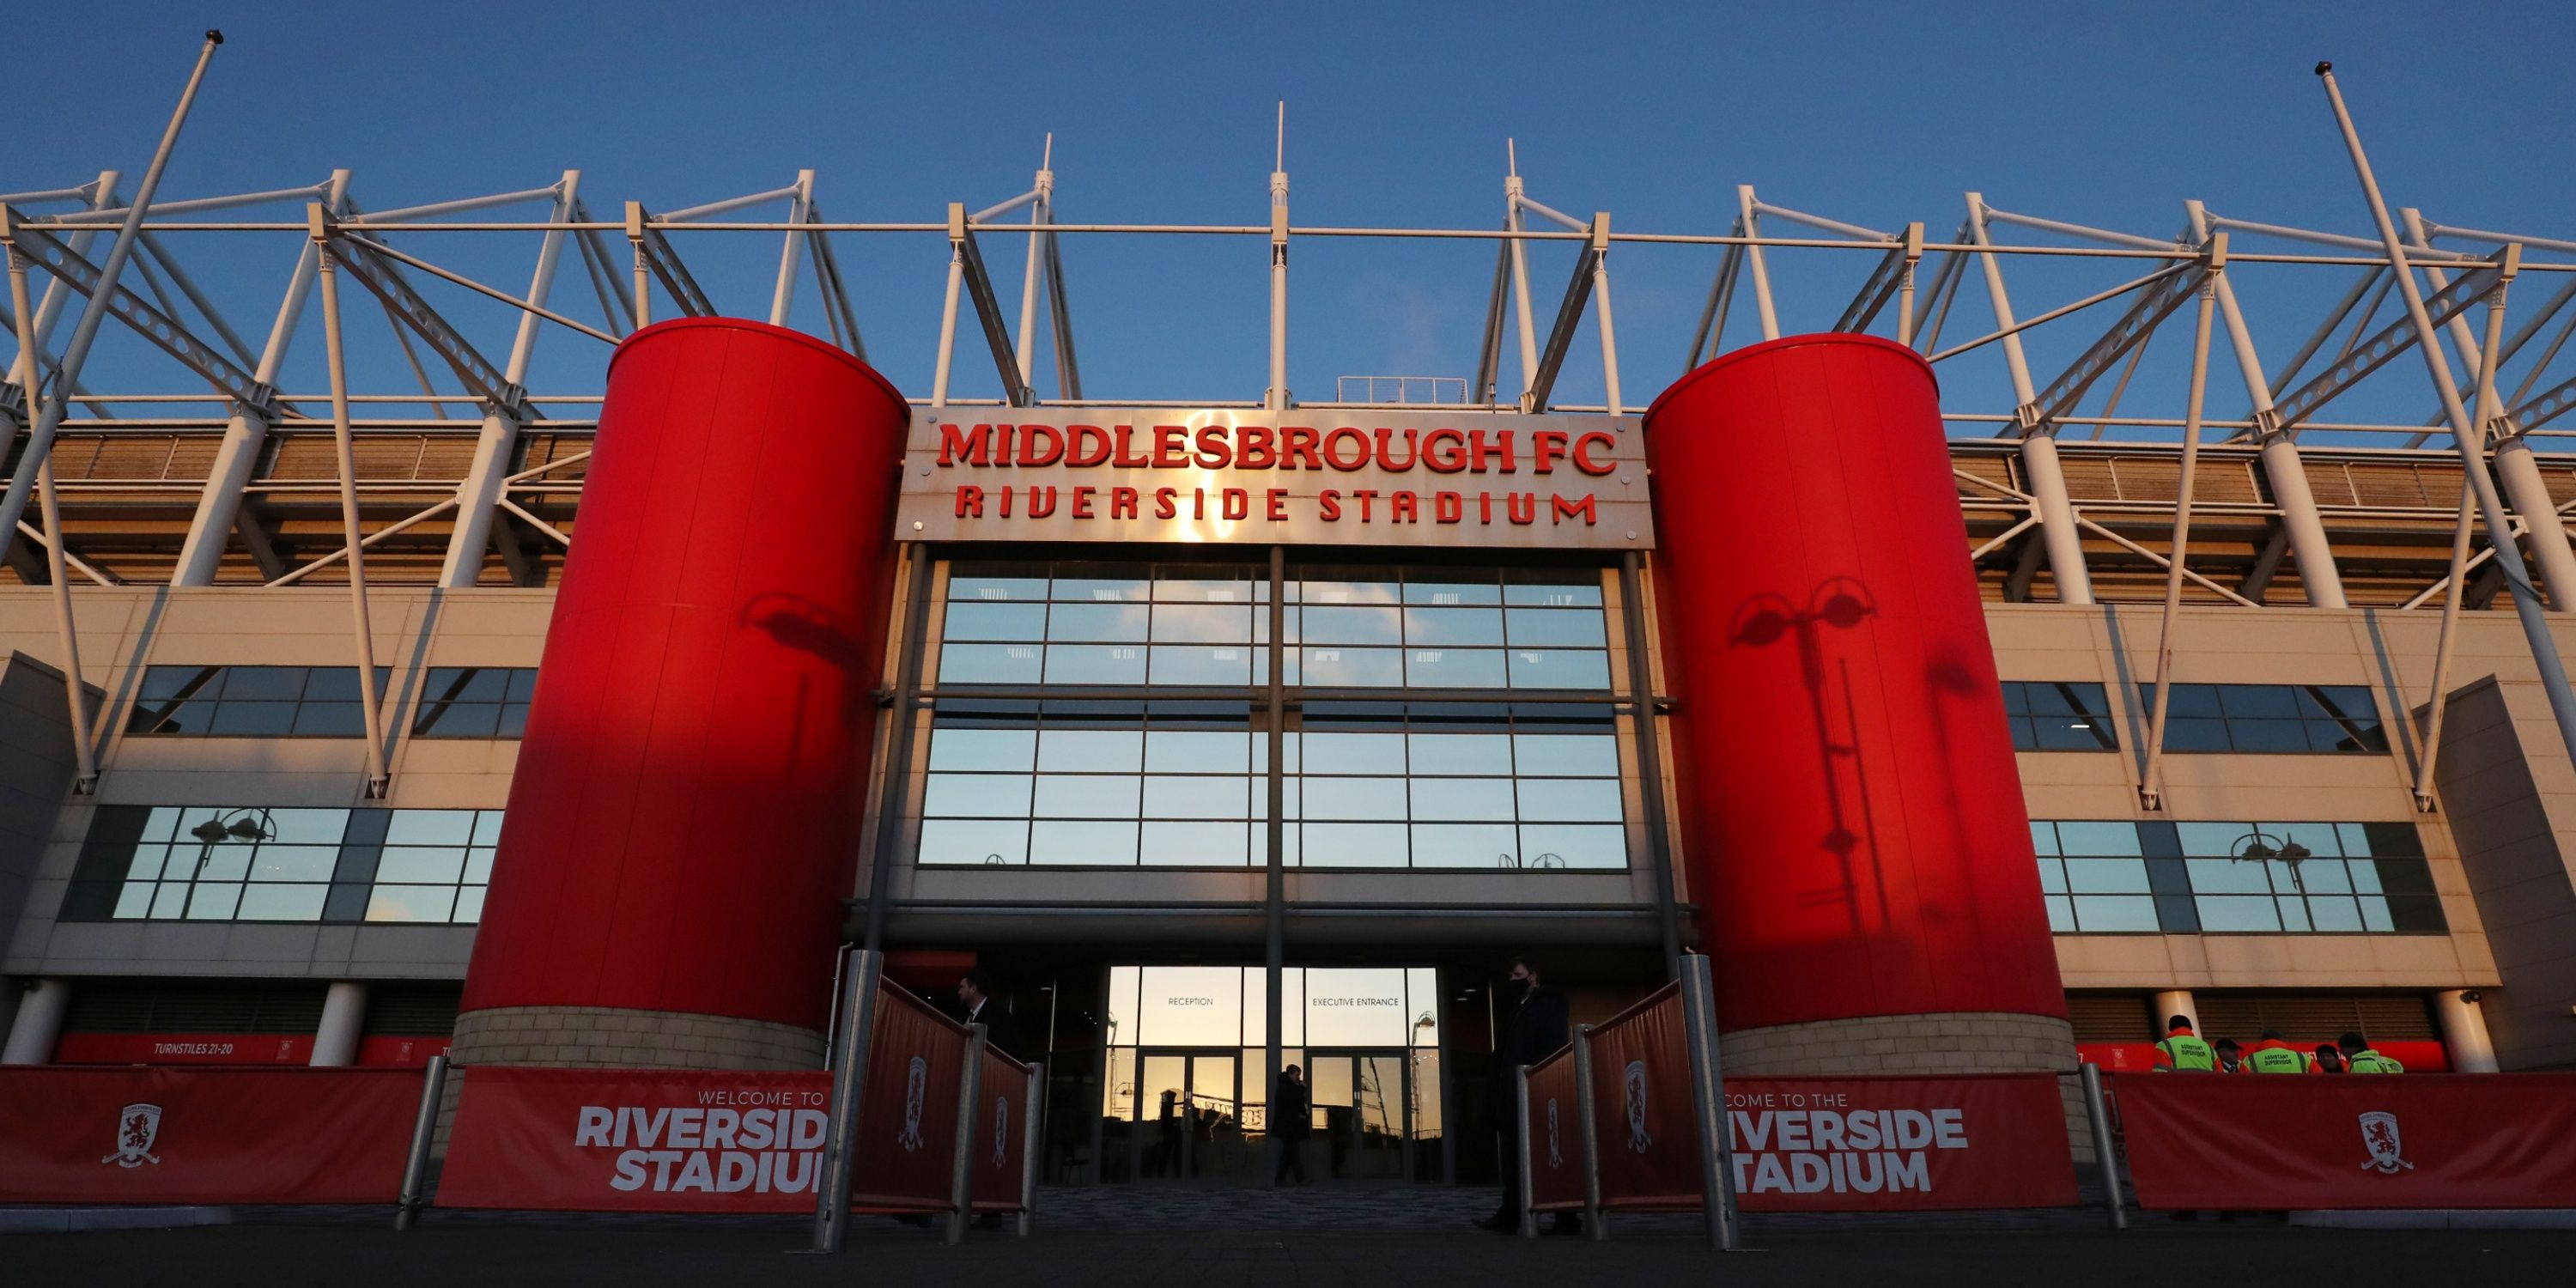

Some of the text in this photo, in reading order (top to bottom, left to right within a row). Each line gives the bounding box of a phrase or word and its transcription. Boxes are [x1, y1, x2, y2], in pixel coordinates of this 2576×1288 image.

[936, 423, 1618, 476] MIDDLESBROUGH FC
[955, 485, 1597, 525] RIVERSIDE STADIUM
[1168, 997, 1214, 1007] RECEPTION
[1312, 998, 1400, 1008] EXECUTIVE ENTRANCE
[155, 1043, 234, 1055] TURNSTILES 21-20
[698, 1091, 824, 1106] WELCOME TO
[1724, 1093, 1848, 1108] COME TO THE
[574, 1106, 829, 1150] RIVERSID
[1727, 1109, 1968, 1151] IVERSIDE
[1731, 1151, 1931, 1194] TADIUM
